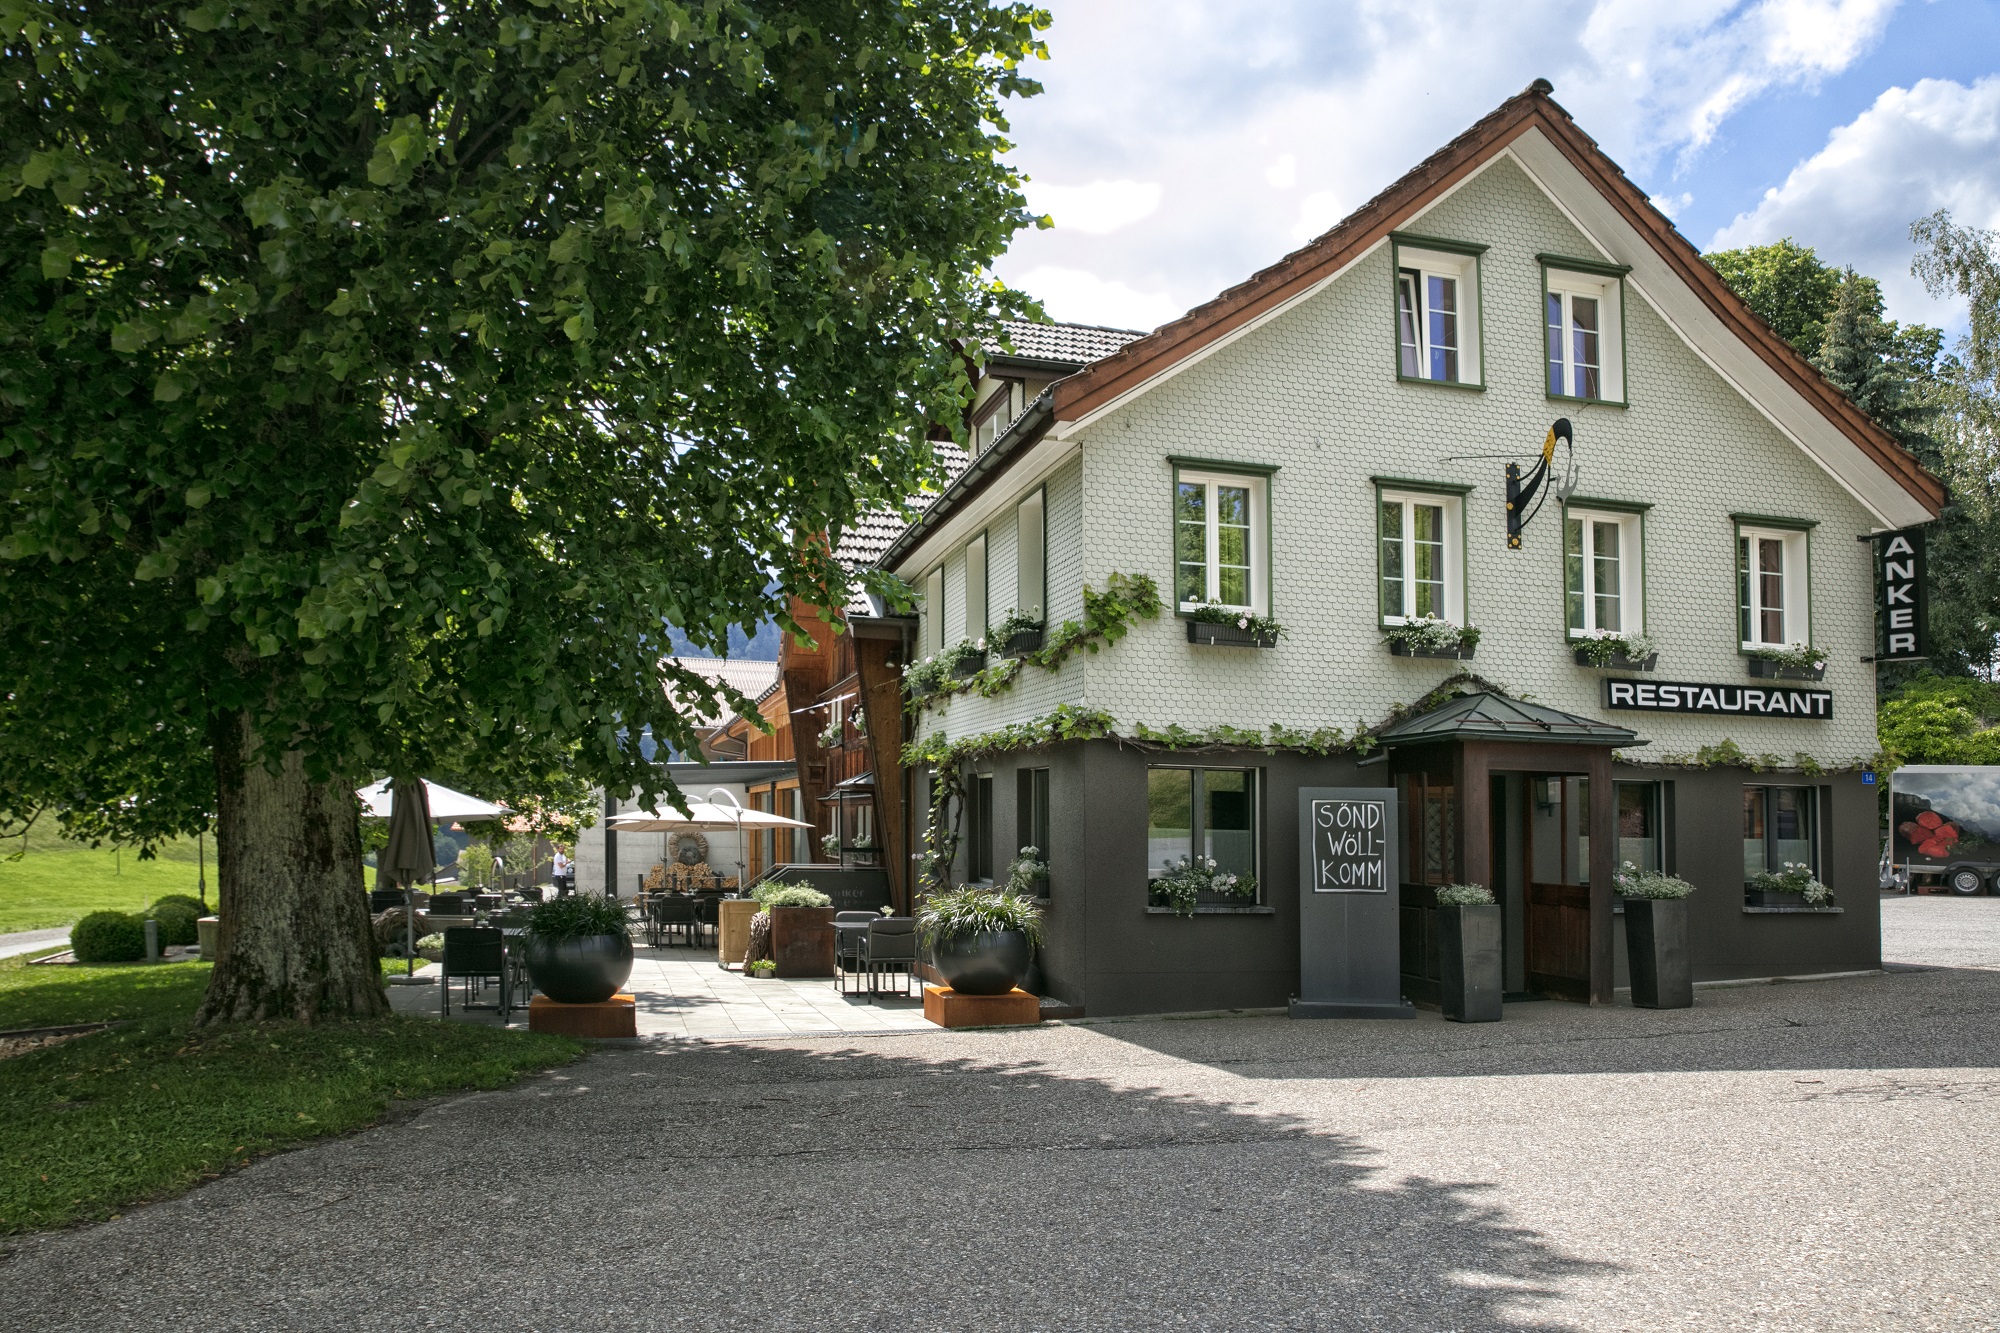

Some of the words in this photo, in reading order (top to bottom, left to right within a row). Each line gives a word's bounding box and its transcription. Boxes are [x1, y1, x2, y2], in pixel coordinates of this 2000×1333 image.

[1884, 536, 1916, 653] ANKER
[1610, 682, 1831, 715] RESTAURANT
[1865, 774, 1873, 782] 14
[1317, 803, 1380, 829] SÖND
[1327, 831, 1384, 856] WÖLL-
[1321, 859, 1382, 888] KOMM
